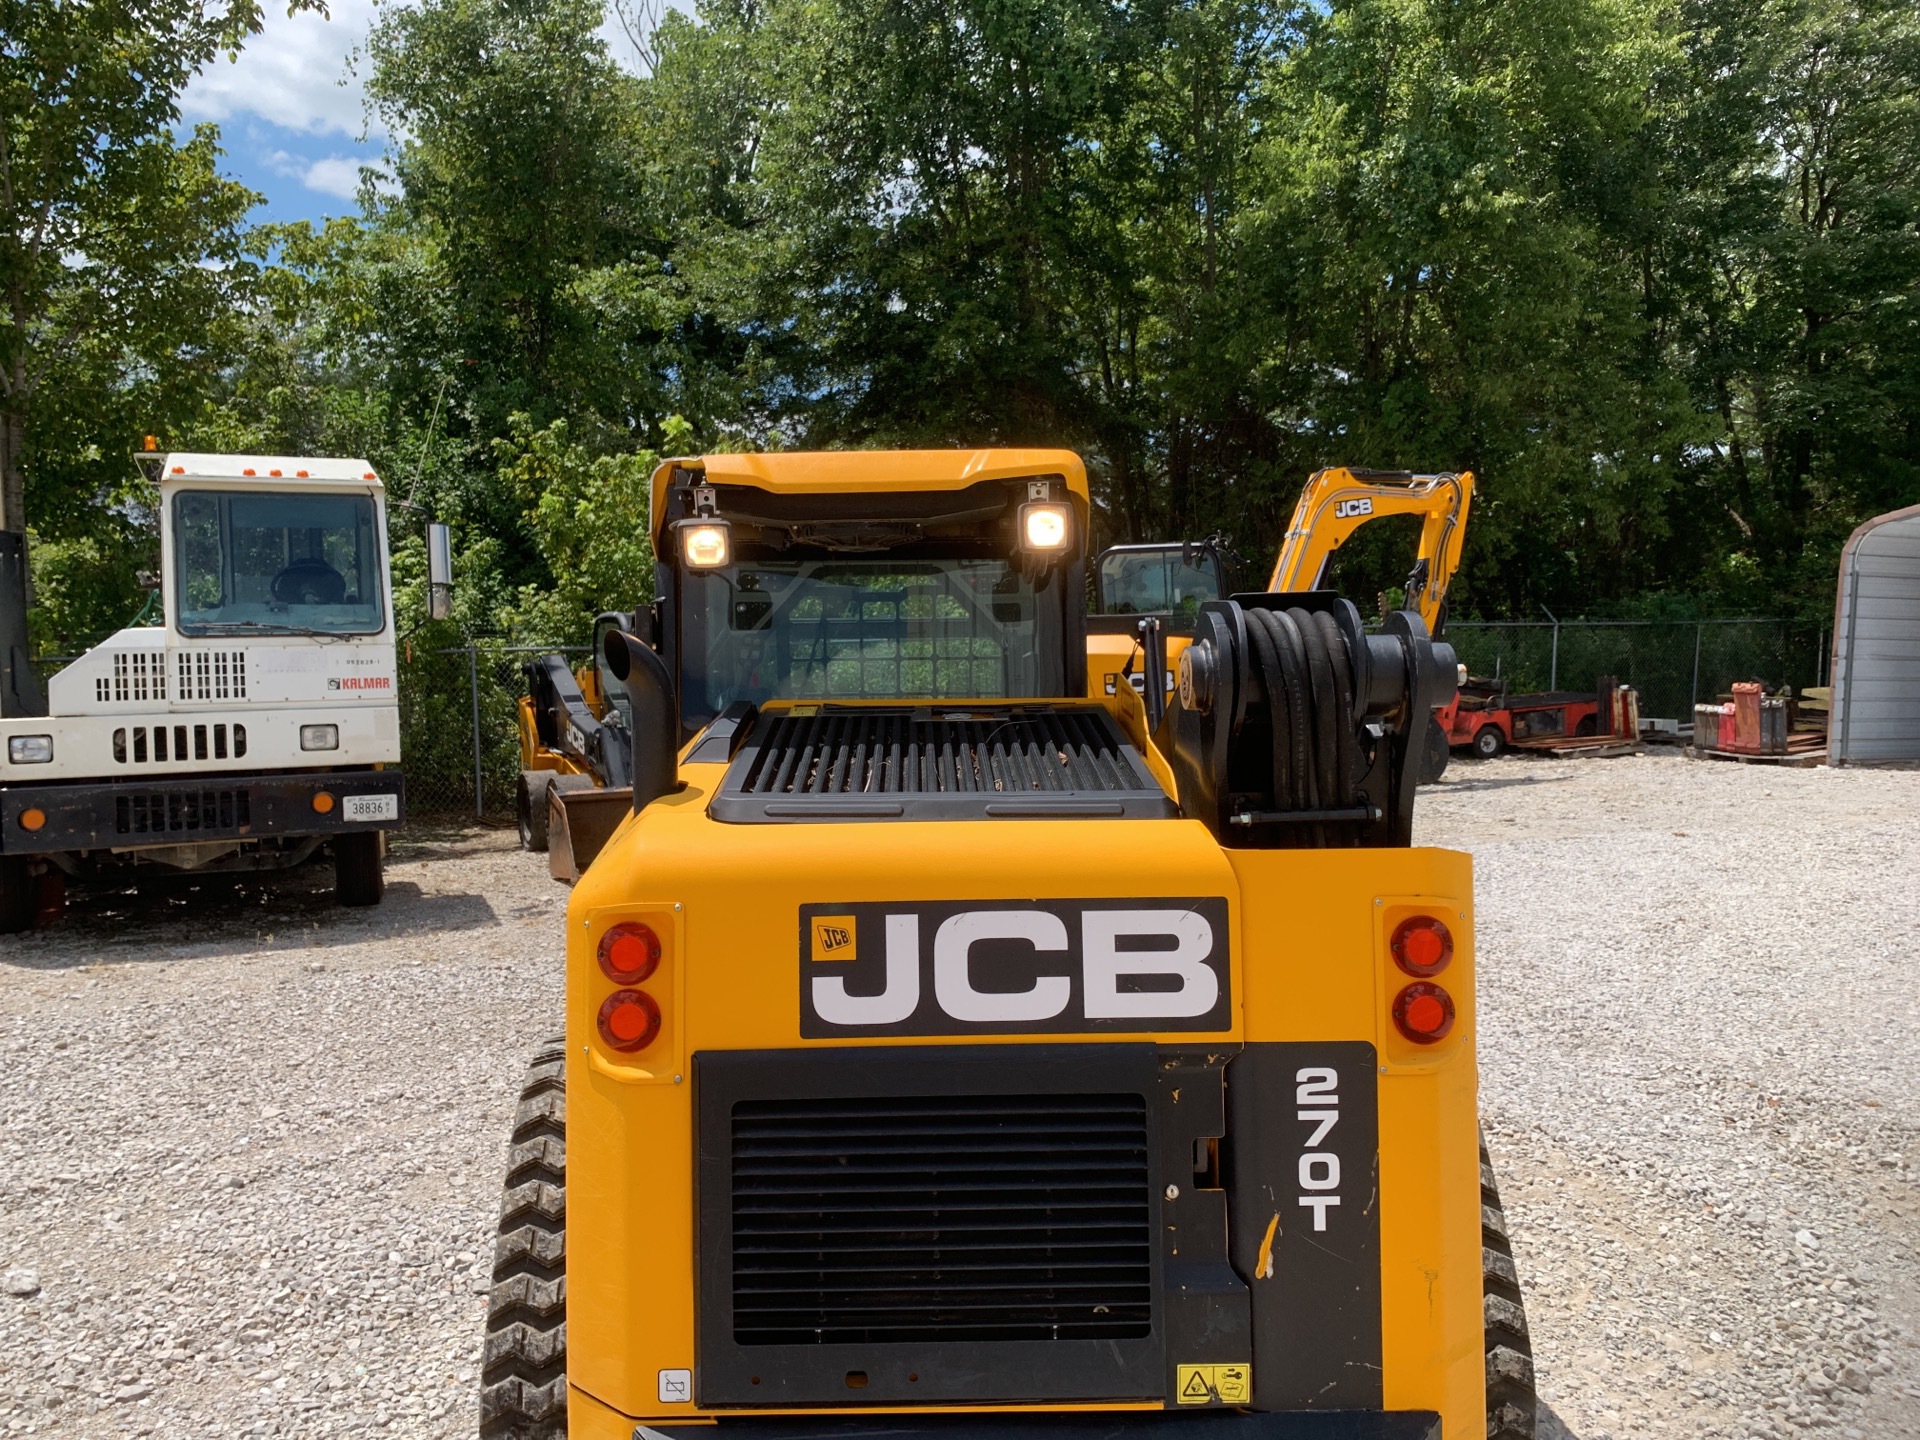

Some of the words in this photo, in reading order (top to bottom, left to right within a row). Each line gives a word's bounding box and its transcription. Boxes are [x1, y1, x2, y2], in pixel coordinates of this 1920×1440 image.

[1335, 498, 1373, 518] JCB
[342, 677, 390, 690] KALMAR
[566, 721, 586, 756] JCB
[352, 801, 383, 814] 38836
[823, 928, 849, 949] JCB
[811, 909, 1218, 1025] JCB
[1295, 1067, 1341, 1232] 270T
